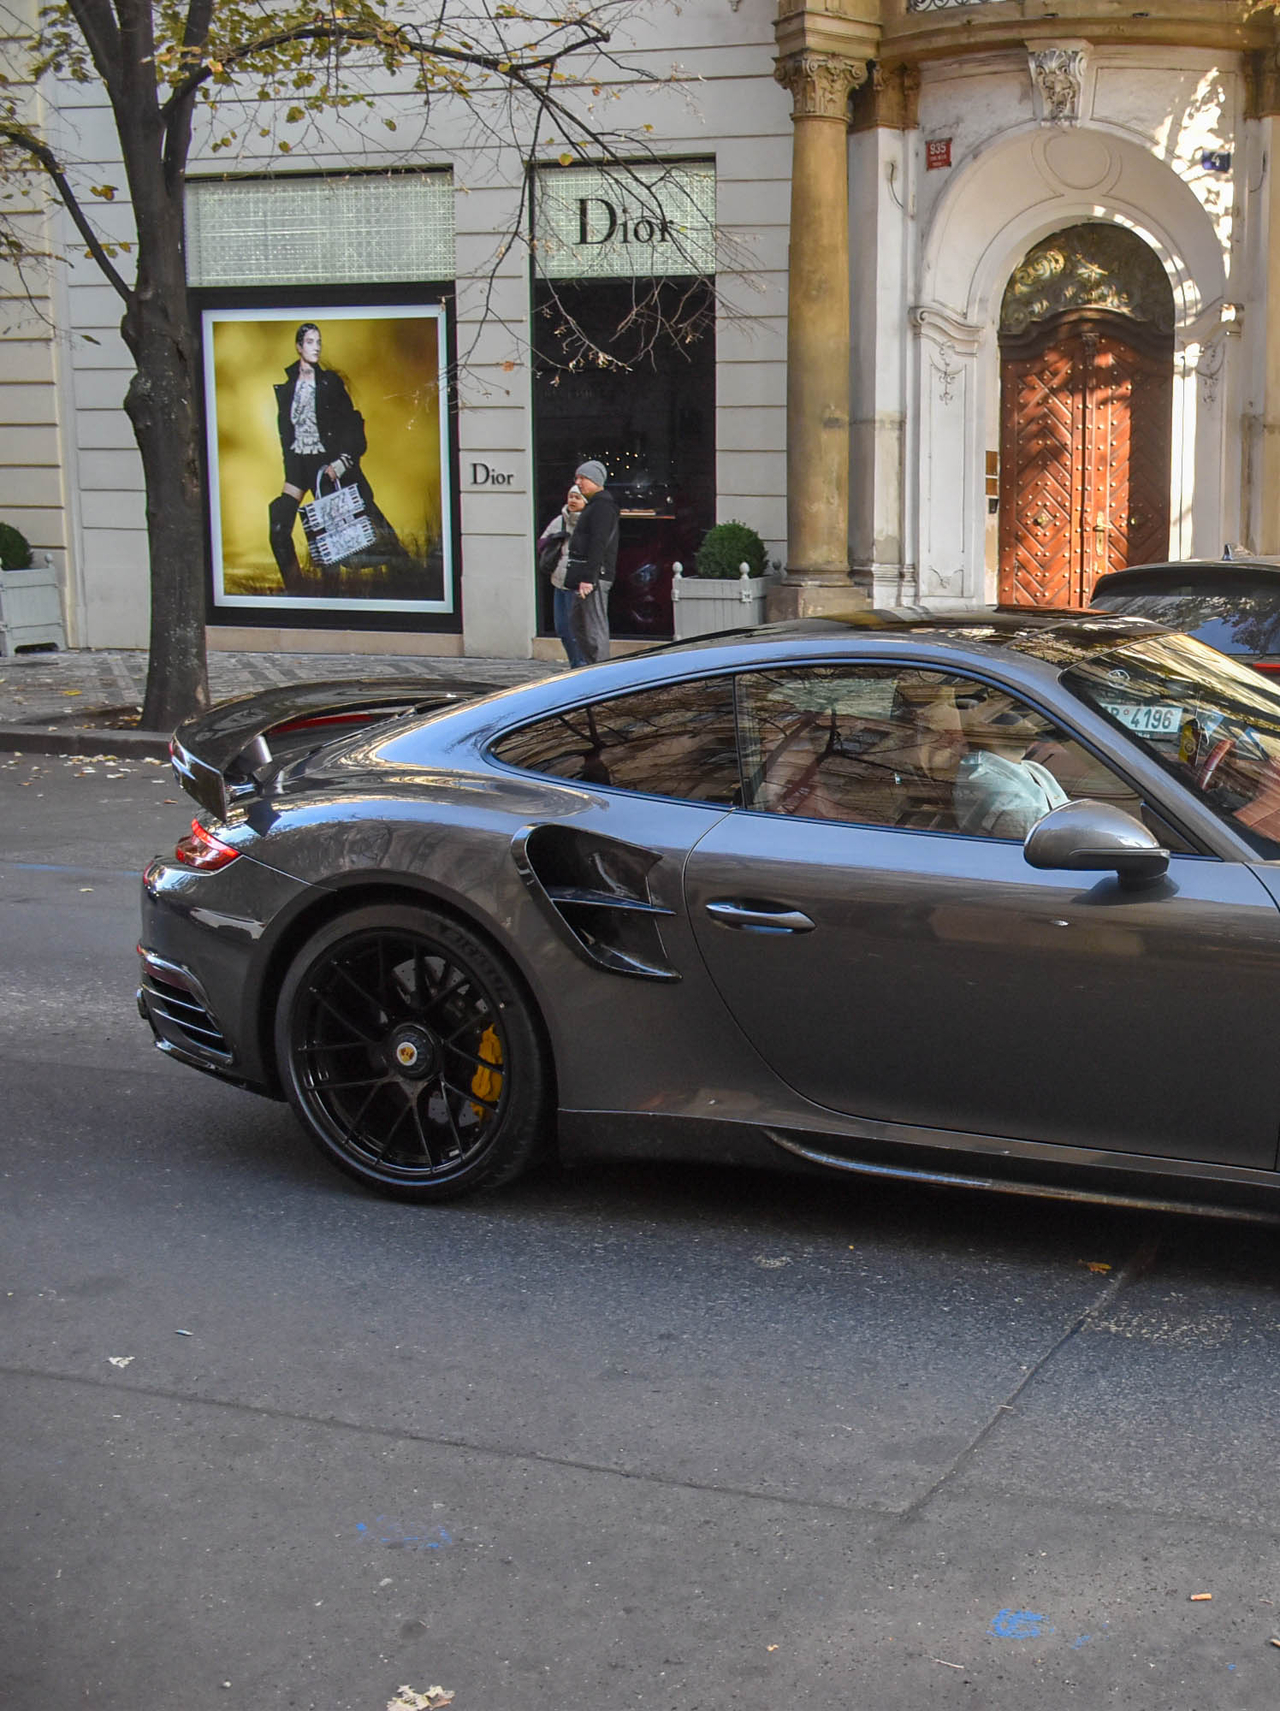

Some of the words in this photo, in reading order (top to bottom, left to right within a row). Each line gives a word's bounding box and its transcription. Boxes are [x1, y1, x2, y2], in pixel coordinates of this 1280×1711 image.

[573, 198, 674, 245] Dior
[470, 463, 514, 485] Dior
[1131, 708, 1173, 729] 4196
